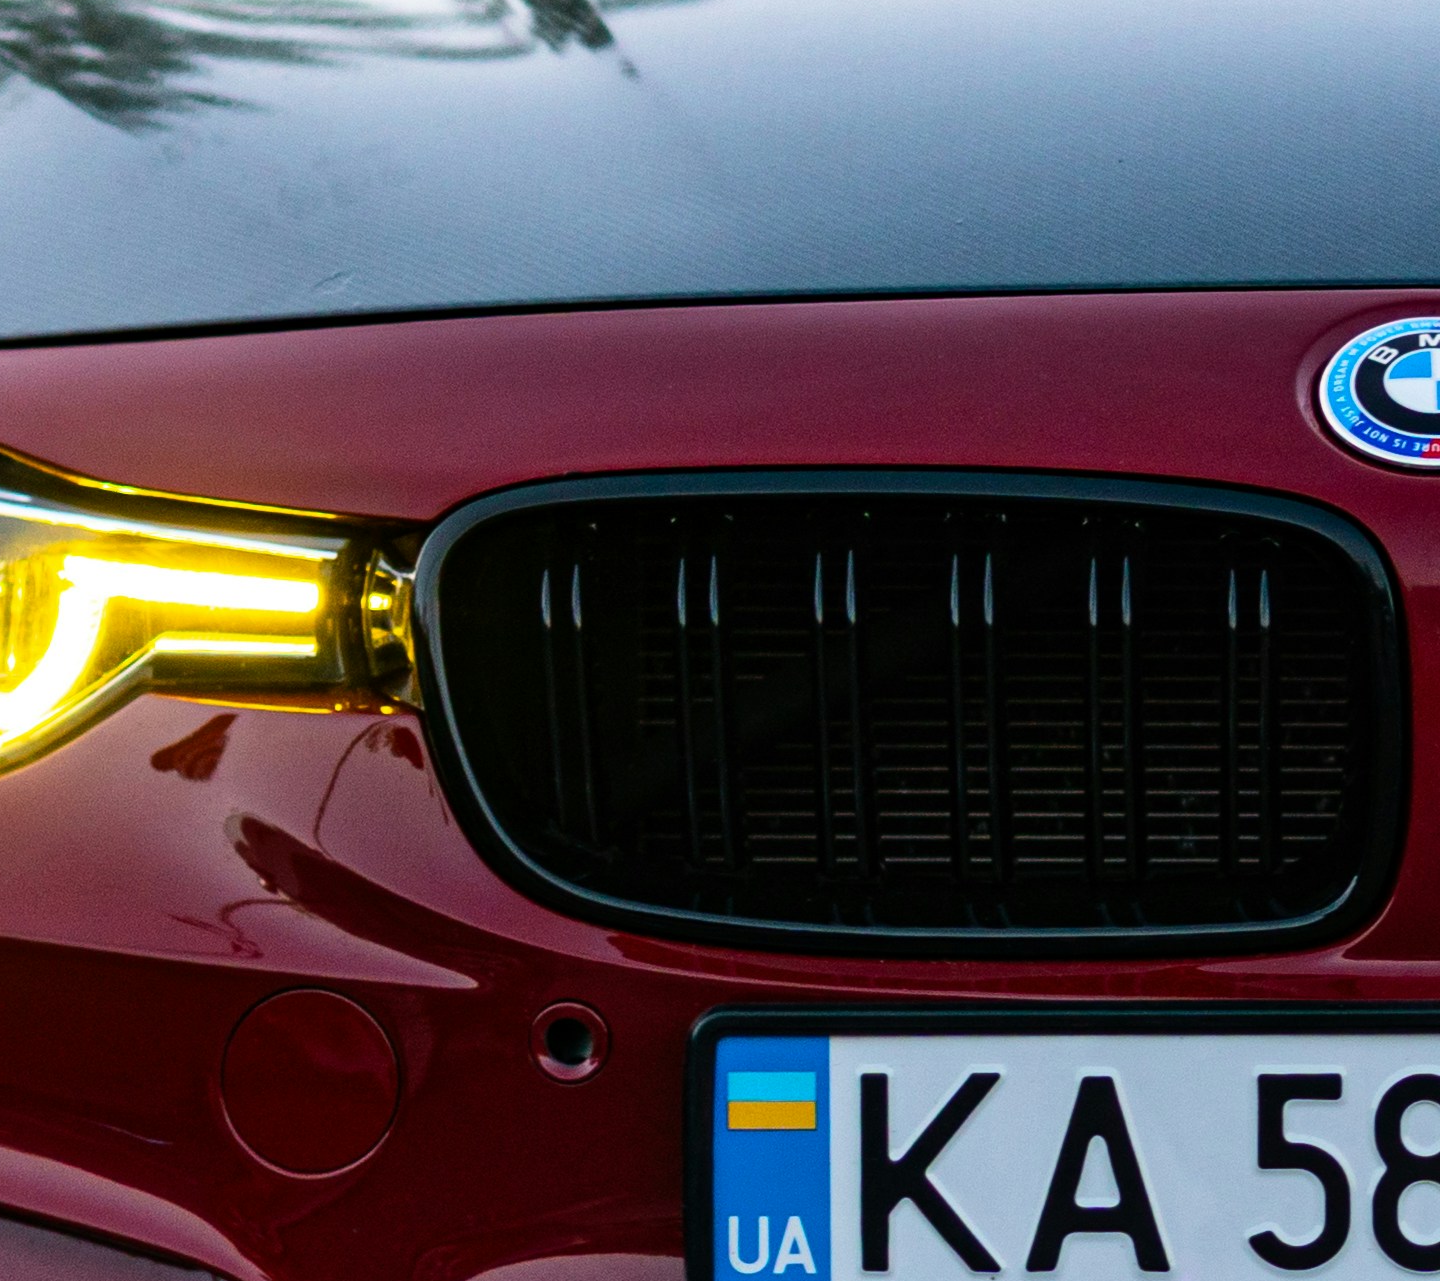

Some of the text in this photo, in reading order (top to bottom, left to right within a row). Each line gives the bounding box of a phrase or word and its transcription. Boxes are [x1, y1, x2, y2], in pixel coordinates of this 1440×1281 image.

[1334, 359, 1349, 393] DREAM
[1340, 406, 1364, 427] JUST
[1362, 425, 1389, 443] NOT
[1392, 439, 1407, 449] IS
[859, 1070, 1170, 1273] KA
[728, 1217, 817, 1276] UA
